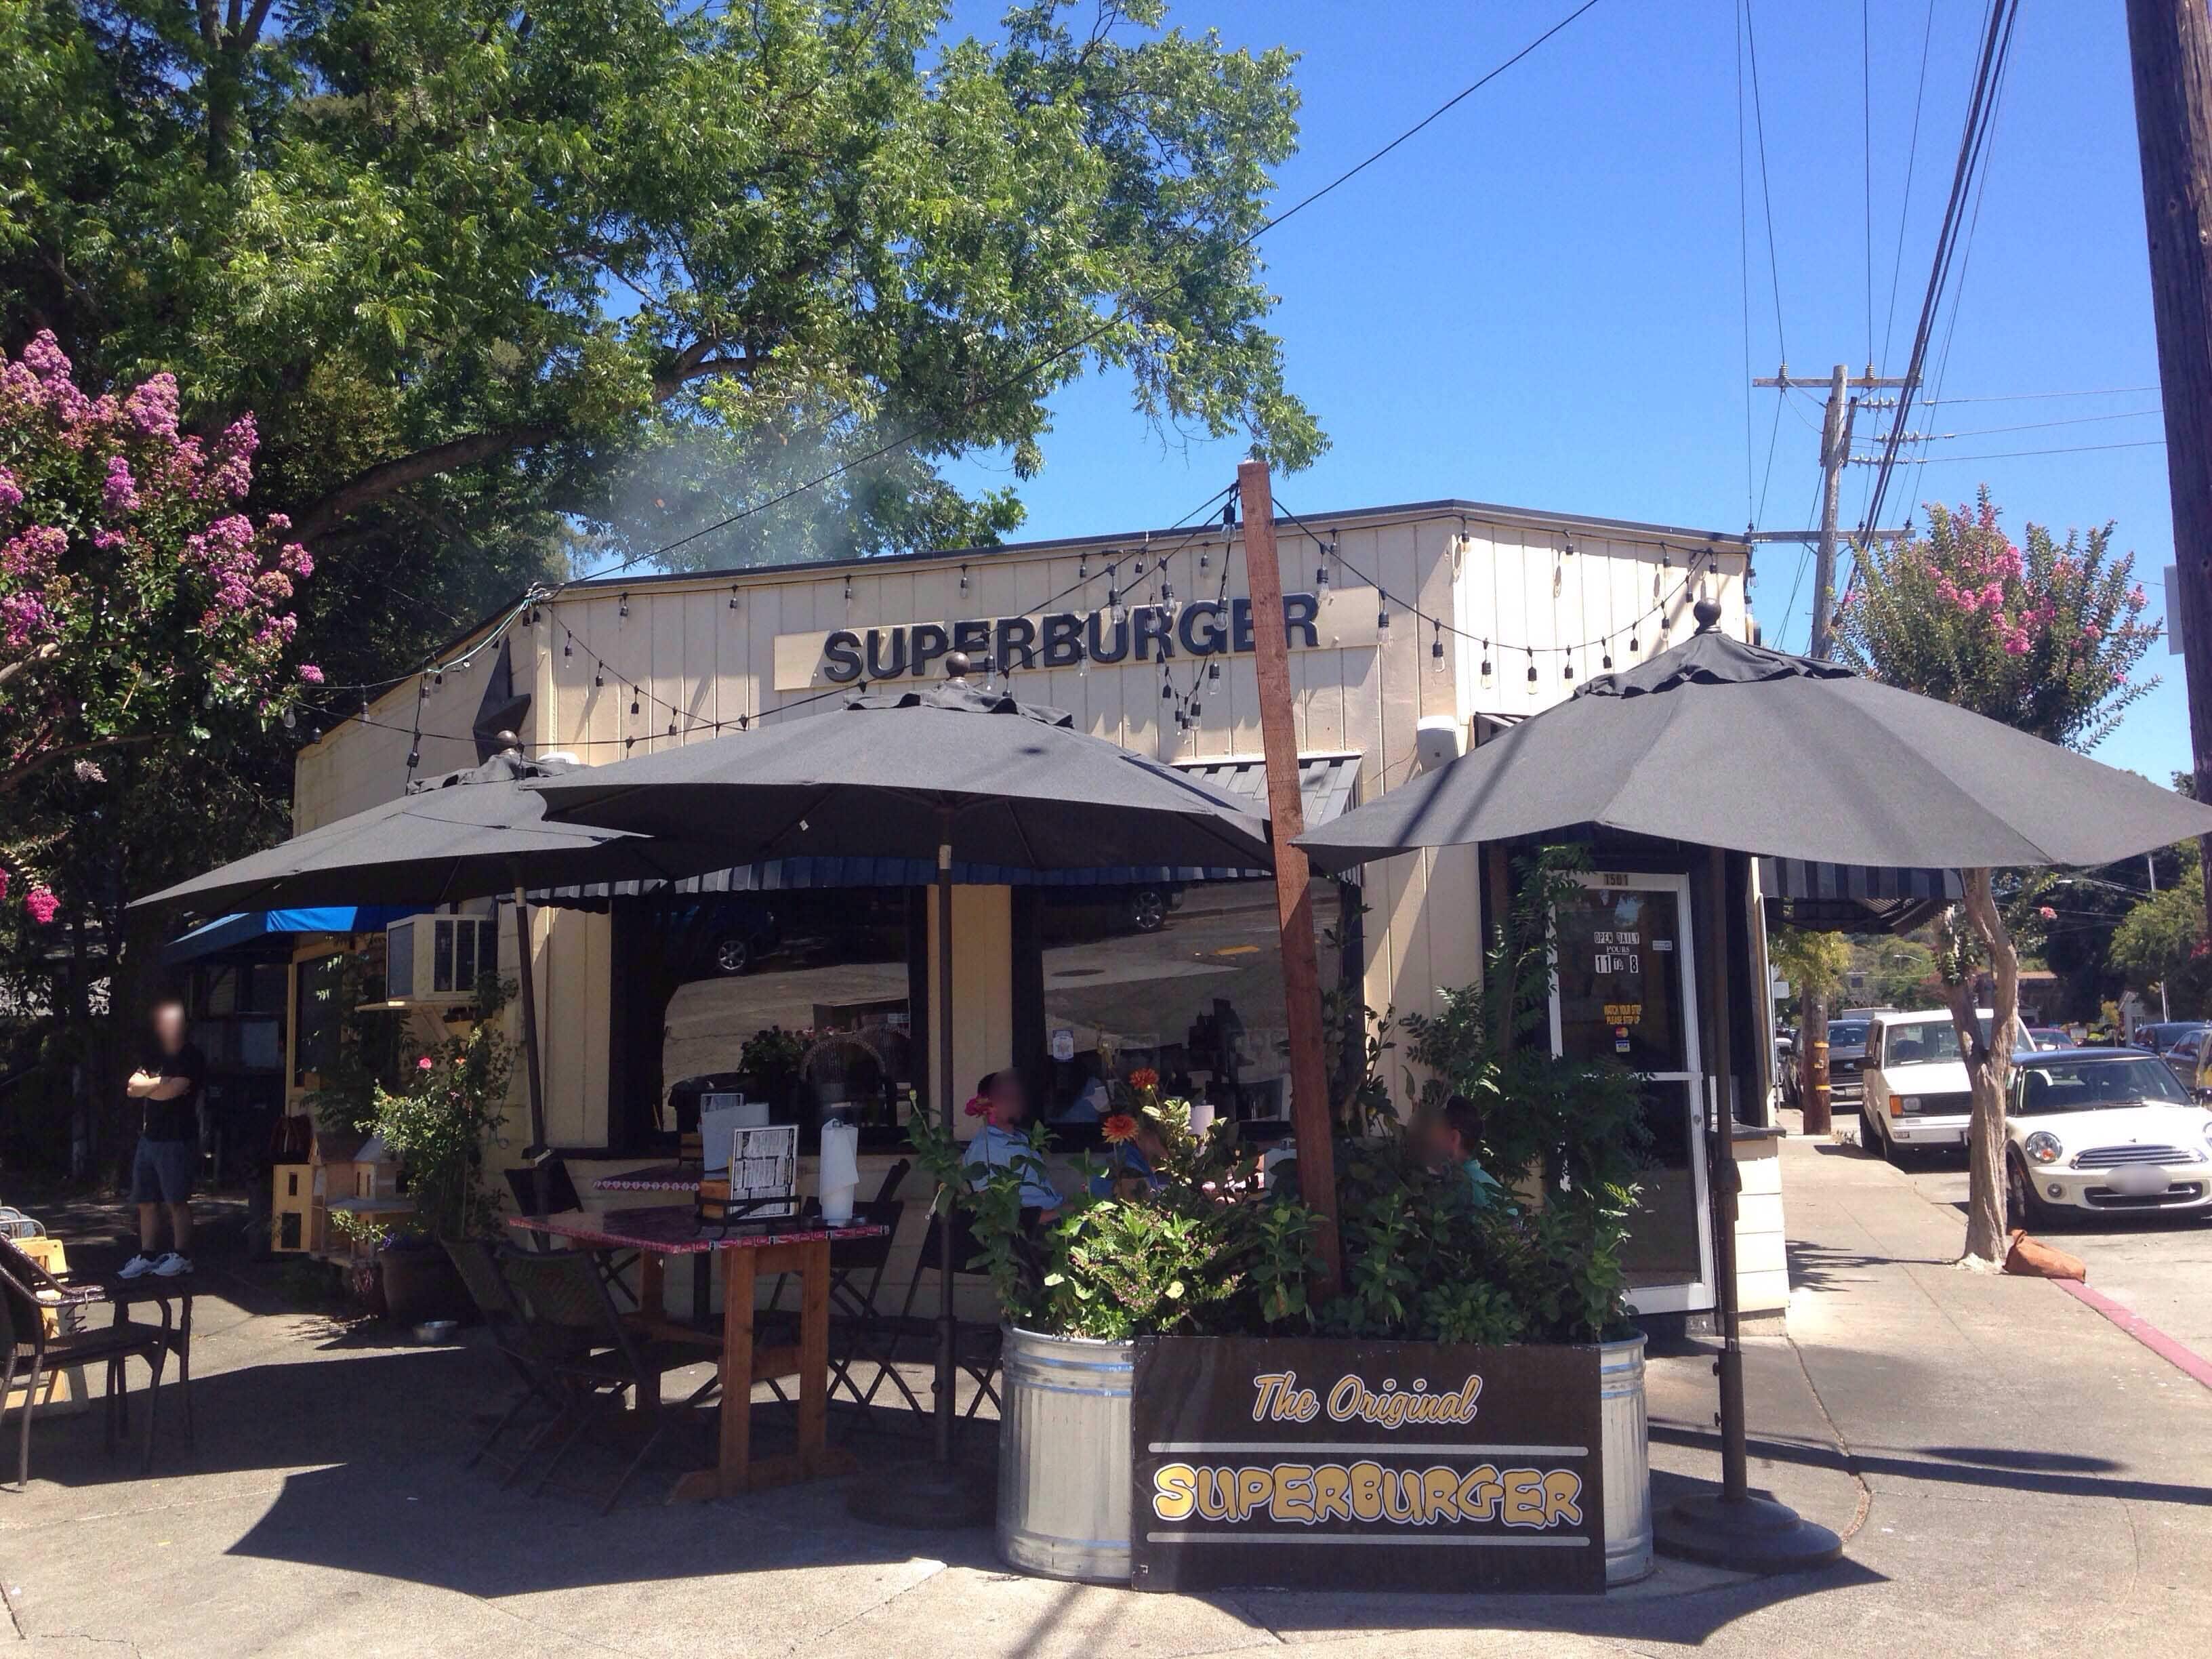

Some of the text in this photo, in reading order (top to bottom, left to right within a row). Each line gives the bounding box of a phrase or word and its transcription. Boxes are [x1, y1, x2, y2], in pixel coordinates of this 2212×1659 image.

[823, 592, 1320, 682] SUPERBURGER
[1595, 932, 1639, 943] OPEN DAILY
[1596, 956, 1611, 972] 11
[1630, 956, 1638, 972] 8
[1253, 1370, 1483, 1429] The Original
[1153, 1460, 1583, 1530] SUPERBURGER
